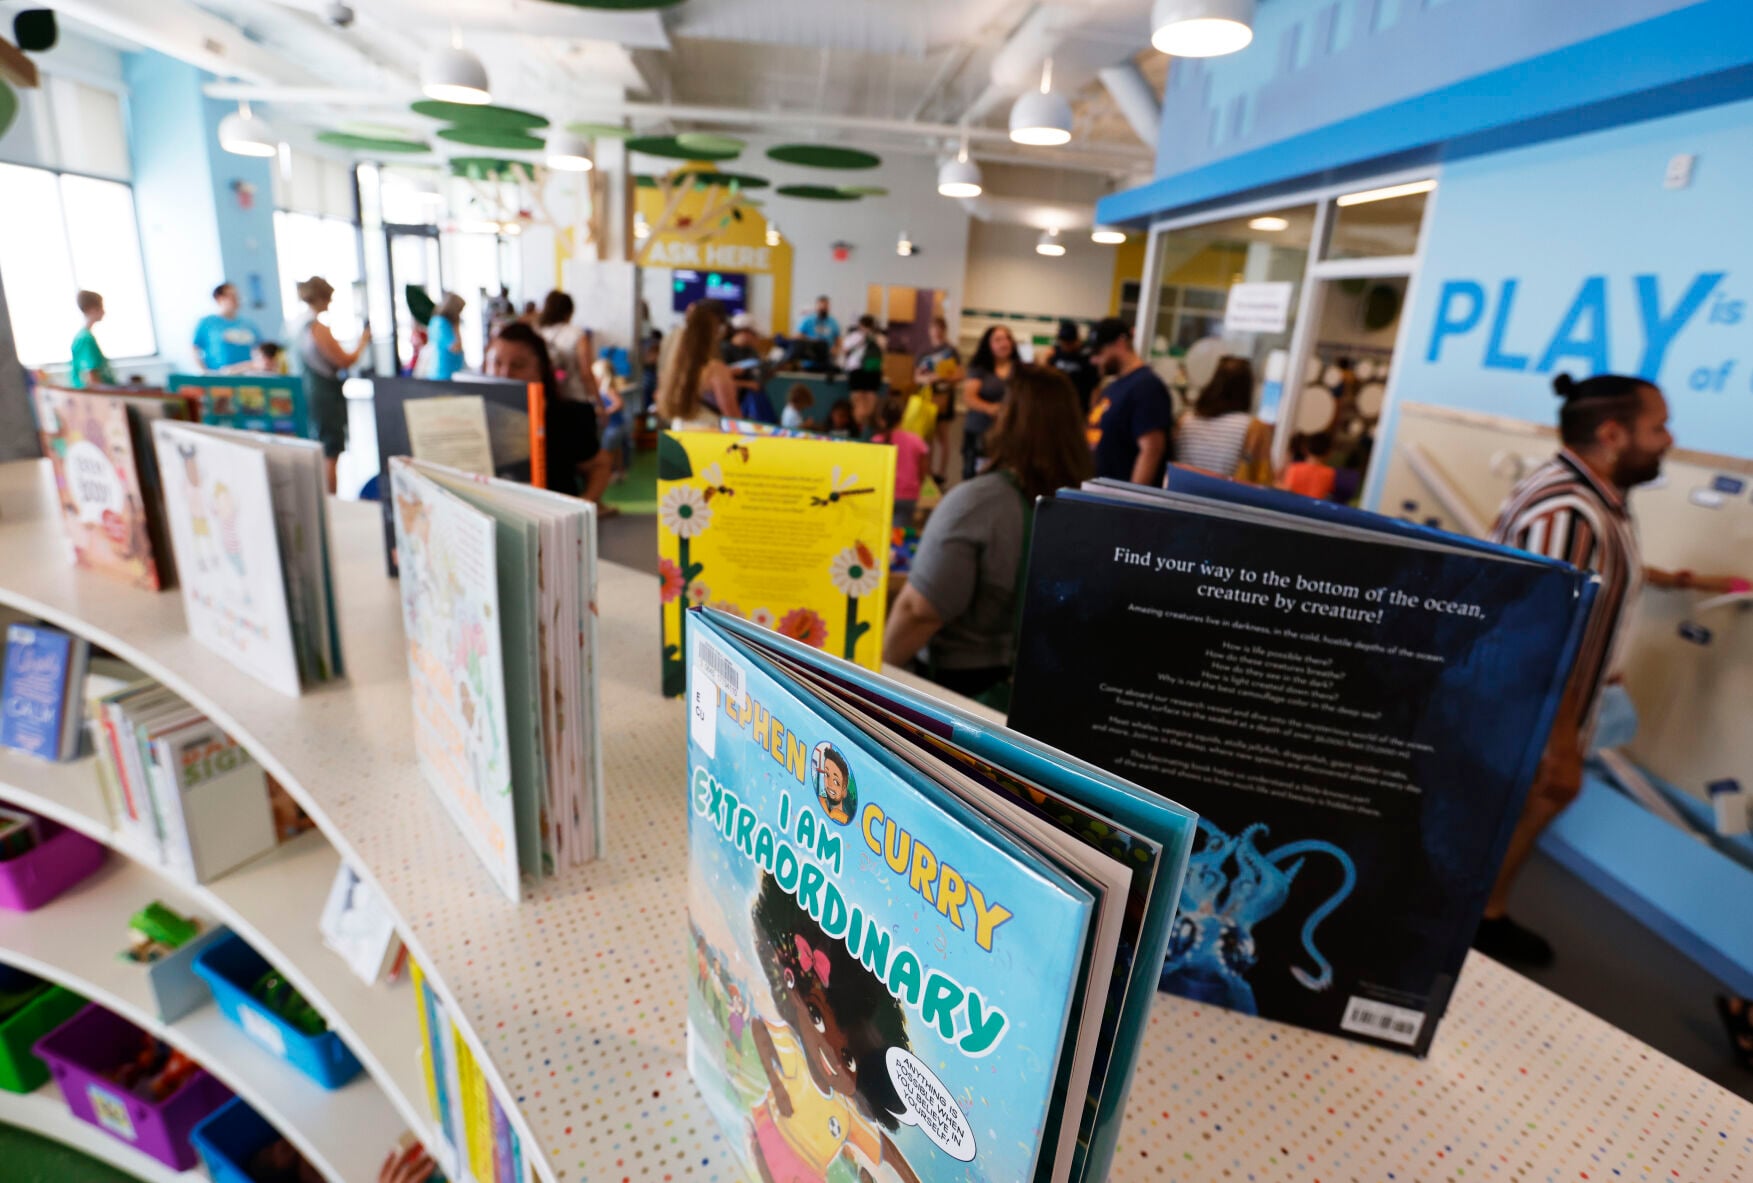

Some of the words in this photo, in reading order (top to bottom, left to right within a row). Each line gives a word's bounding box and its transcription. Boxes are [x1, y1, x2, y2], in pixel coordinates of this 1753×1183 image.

[648, 240, 701, 265] ASK
[705, 243, 771, 269] HERE
[1425, 270, 1727, 382] PLAY
[1708, 290, 1746, 324] is
[1690, 359, 1735, 393] of
[1113, 547, 1151, 566] Find
[1154, 557, 1195, 572] your
[1200, 558, 1234, 581] way
[1239, 569, 1256, 582] to
[1262, 571, 1290, 587] the
[1296, 575, 1359, 598] bottom
[1365, 588, 1388, 602] of
[1389, 590, 1419, 607] the
[1424, 599, 1486, 619] ocean,
[1197, 585, 1269, 605] creature
[1274, 593, 1296, 612] by
[1300, 602, 1384, 624] creature!
[1205, 650, 1224, 658] How
[1211, 662, 1230, 670] How
[1222, 642, 1241, 650] How
[1283, 630, 1297, 638] the
[1397, 649, 1413, 657] the
[716, 685, 808, 786] EPHEN
[861, 802, 1014, 954] CURRY
[780, 793, 790, 830] I
[796, 809, 841, 875] AM
[694, 768, 1006, 1053] EXTRAORDINARY
[895, 1058, 935, 1106] POSSIBLE
[937, 1103, 965, 1138] WHEN
[896, 1070, 914, 1094] YOU
[915, 1093, 949, 1133] BELIEVE
[951, 1132, 961, 1147] IN
[903, 1058, 947, 1107] ANYTHING
[949, 1105, 958, 1119] IS
[903, 1089, 950, 1145] YOURSELF!
